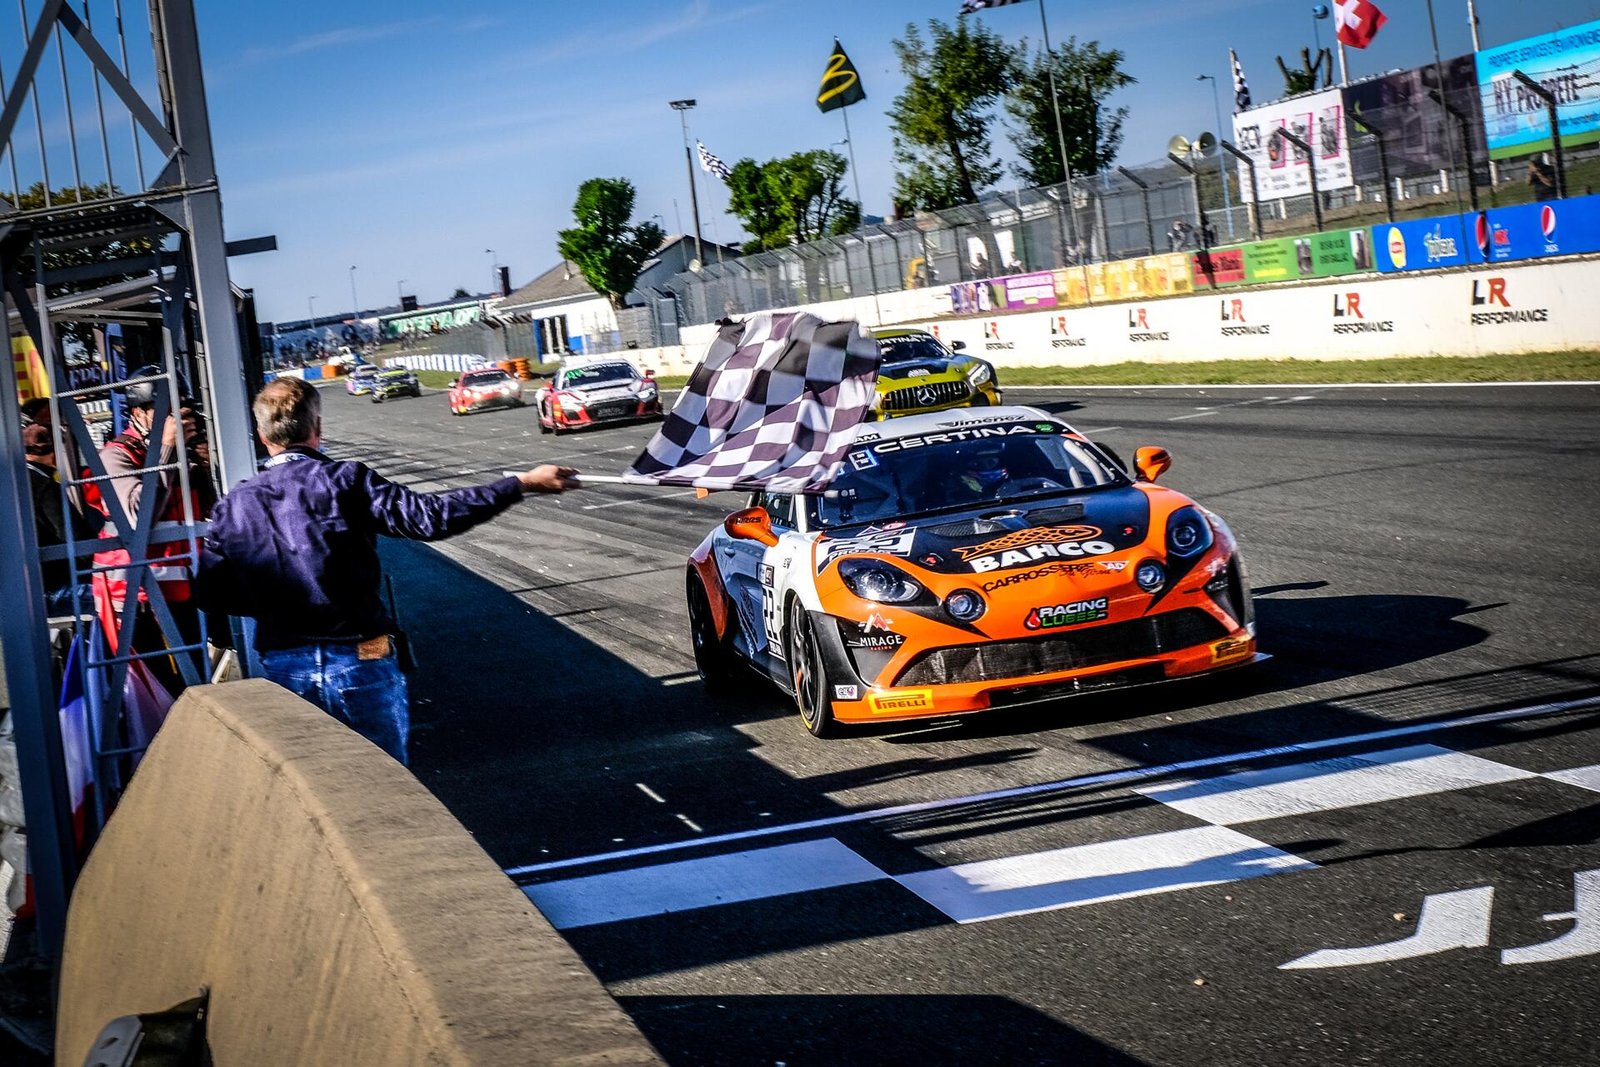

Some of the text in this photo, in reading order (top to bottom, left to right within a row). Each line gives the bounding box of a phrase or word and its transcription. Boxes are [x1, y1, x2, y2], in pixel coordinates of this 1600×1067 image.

[1471, 277, 1511, 307] LR
[1221, 299, 1246, 322] LR
[1333, 292, 1364, 319] LR
[1129, 308, 1150, 330] LR
[1471, 308, 1548, 326] PERFORMANCE
[873, 424, 1036, 454] CERTINA
[966, 540, 1115, 574] BAHCO
[1039, 598, 1106, 618] RACING
[1042, 609, 1097, 627] LUBES
[860, 635, 903, 647] MIRAGE
[875, 692, 926, 711] PIRELLI
